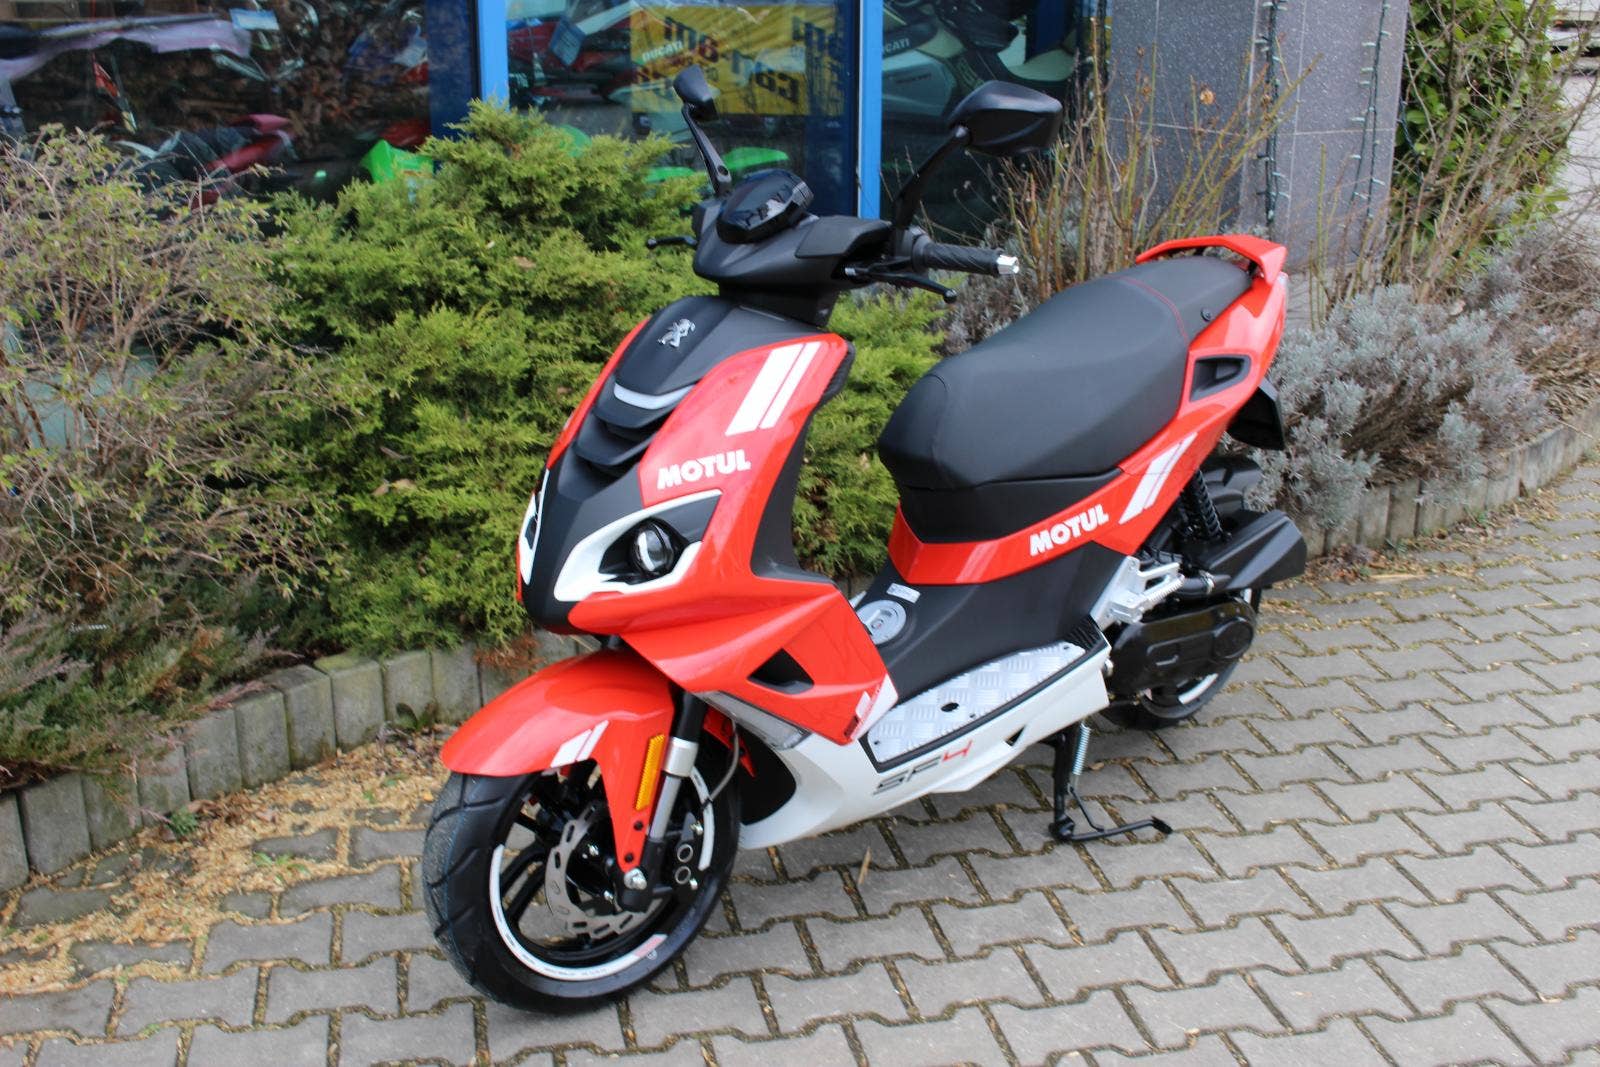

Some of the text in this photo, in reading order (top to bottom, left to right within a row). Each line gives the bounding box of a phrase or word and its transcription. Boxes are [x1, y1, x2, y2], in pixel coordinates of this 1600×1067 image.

[885, 38, 910, 53] CATI
[657, 449, 751, 490] MOTUL
[1029, 504, 1109, 557] MOTUL
